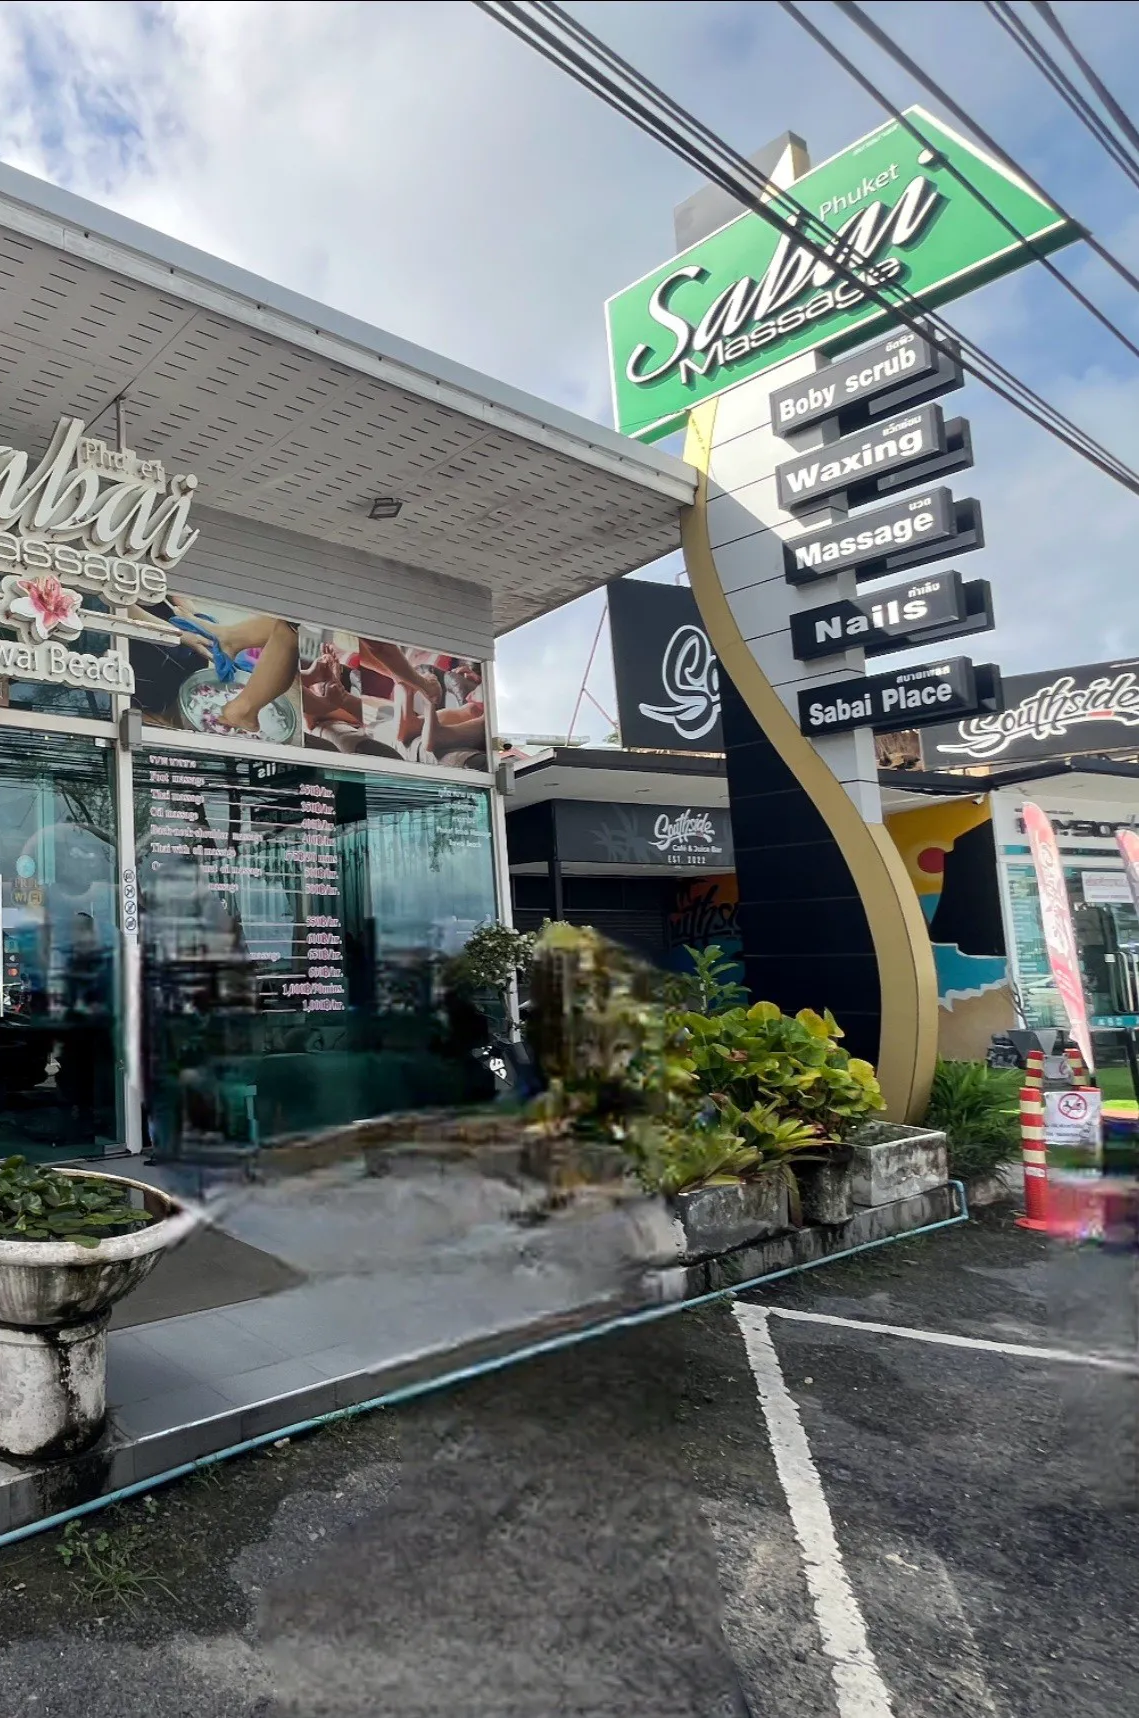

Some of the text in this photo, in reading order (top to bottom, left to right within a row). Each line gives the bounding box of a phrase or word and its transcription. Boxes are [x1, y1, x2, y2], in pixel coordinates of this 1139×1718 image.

[819, 162, 899, 220] Phuket
[626, 149, 950, 384] Sabai
[679, 257, 901, 385] Massage
[779, 347, 916, 422] Boby scrub
[83, 440, 166, 483] Phuet
[786, 427, 923, 493] Waxing
[795, 510, 935, 569] Massage
[815, 597, 929, 643] Nails
[50, 645, 135, 686] Beach
[809, 679, 953, 726] Sabai Place
[648, 809, 716, 851] Southside
